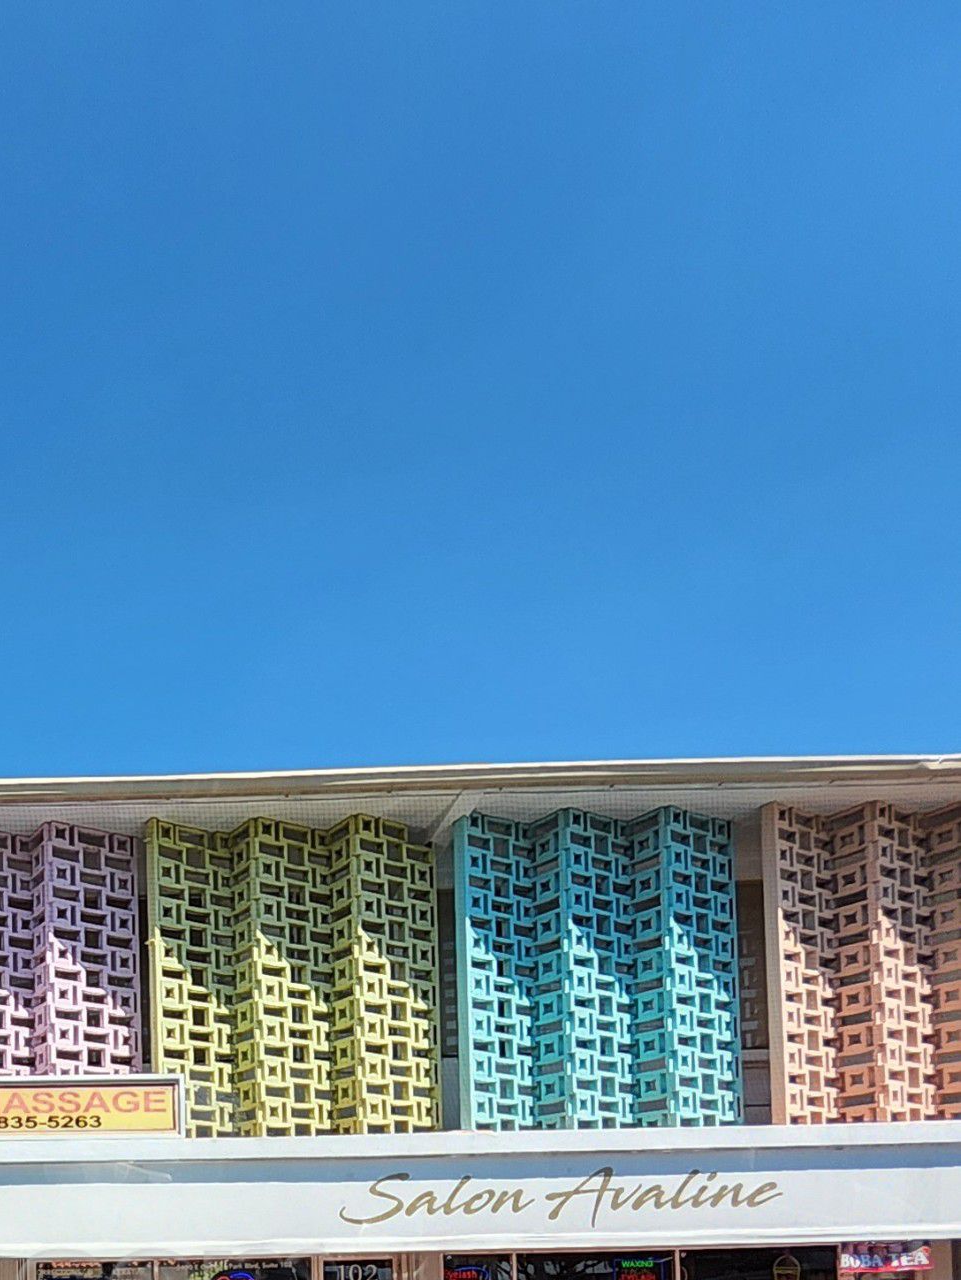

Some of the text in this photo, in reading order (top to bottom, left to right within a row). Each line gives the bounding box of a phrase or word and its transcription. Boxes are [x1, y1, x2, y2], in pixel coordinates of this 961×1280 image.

[338, 1166, 785, 1229] Salon Avaline
[621, 1260, 654, 1268] WAXING
[840, 1251, 930, 1268] BOBA TEA
